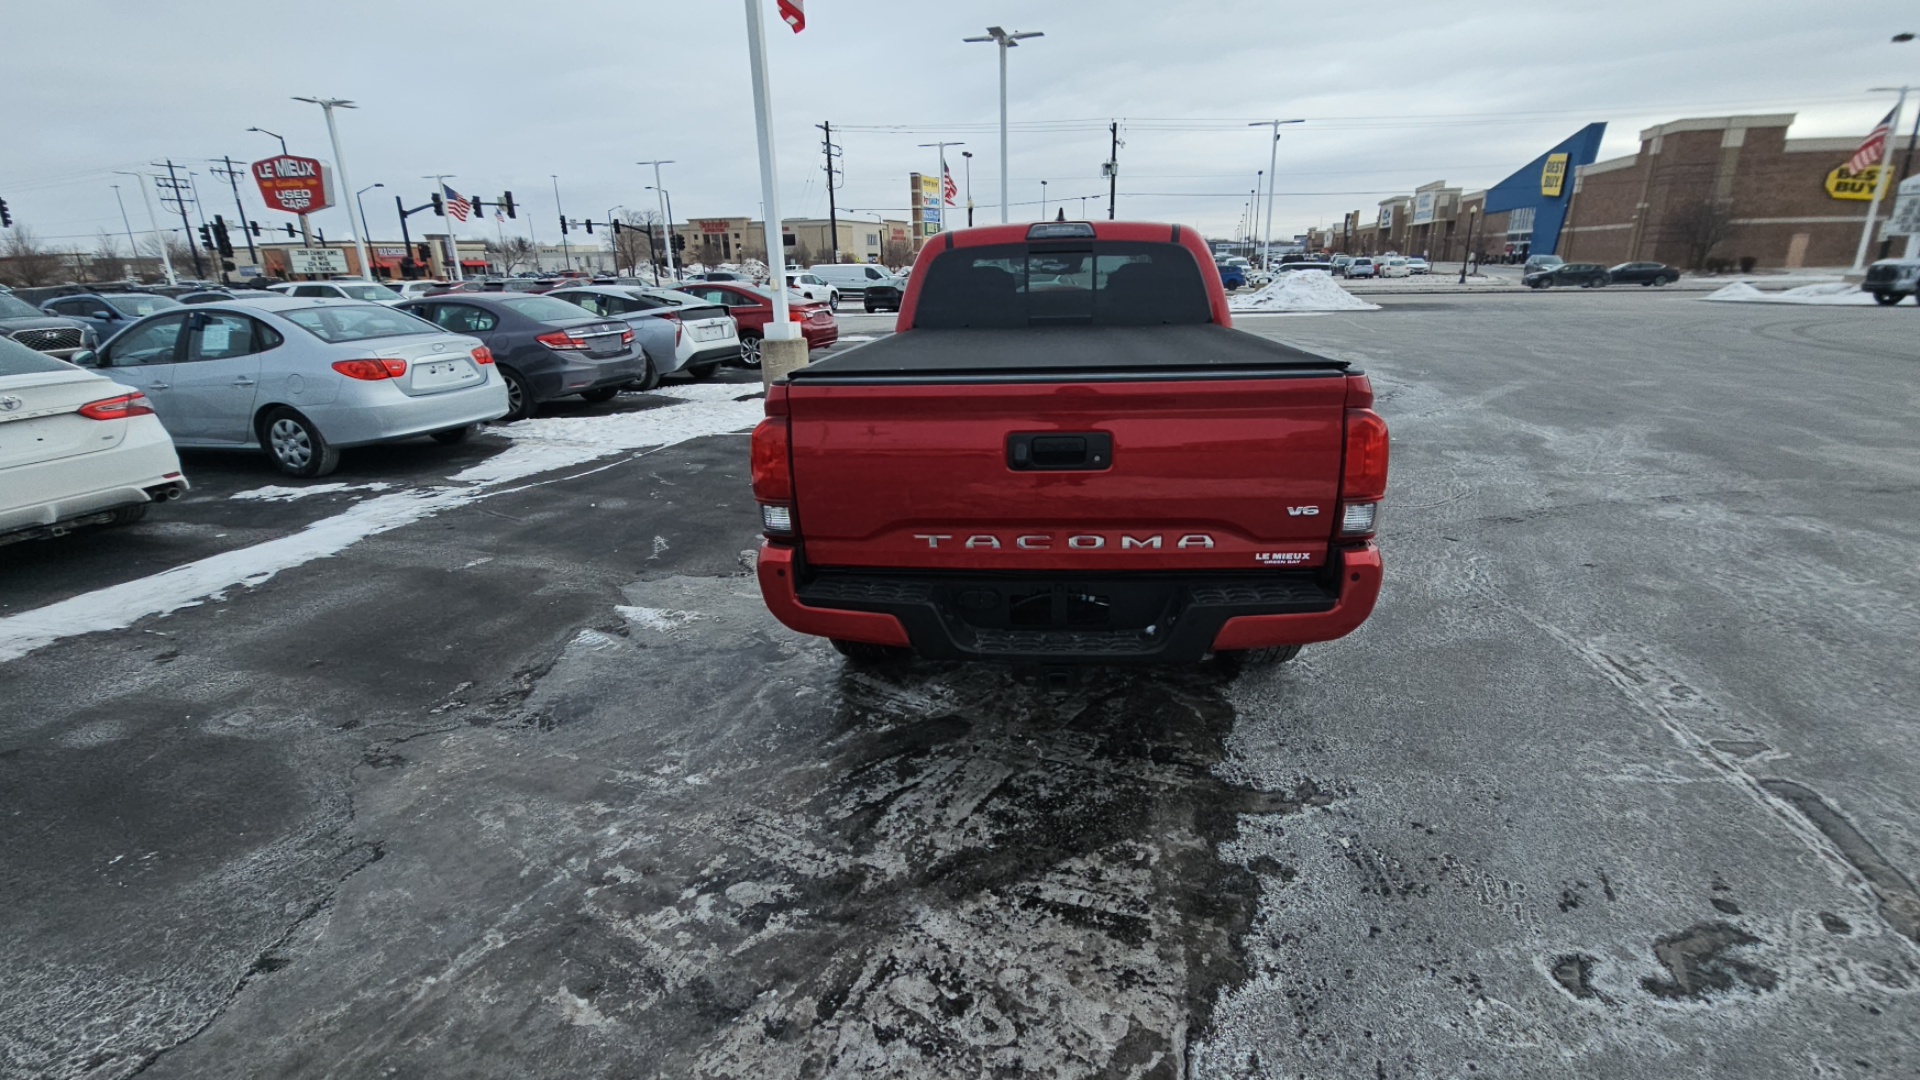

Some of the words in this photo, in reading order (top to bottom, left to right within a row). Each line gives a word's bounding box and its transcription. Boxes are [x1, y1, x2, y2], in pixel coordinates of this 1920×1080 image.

[257, 163, 275, 178] LE
[274, 158, 315, 177] MIEUX
[1547, 161, 1565, 173] BEST
[1544, 175, 1561, 187] BUY
[275, 189, 311, 199] USED
[282, 198, 310, 209] CARS
[1287, 505, 1319, 516] V6
[913, 534, 1215, 549] TACOMA
[1255, 552, 1270, 560] LE
[1272, 552, 1310, 560] MIEUX
